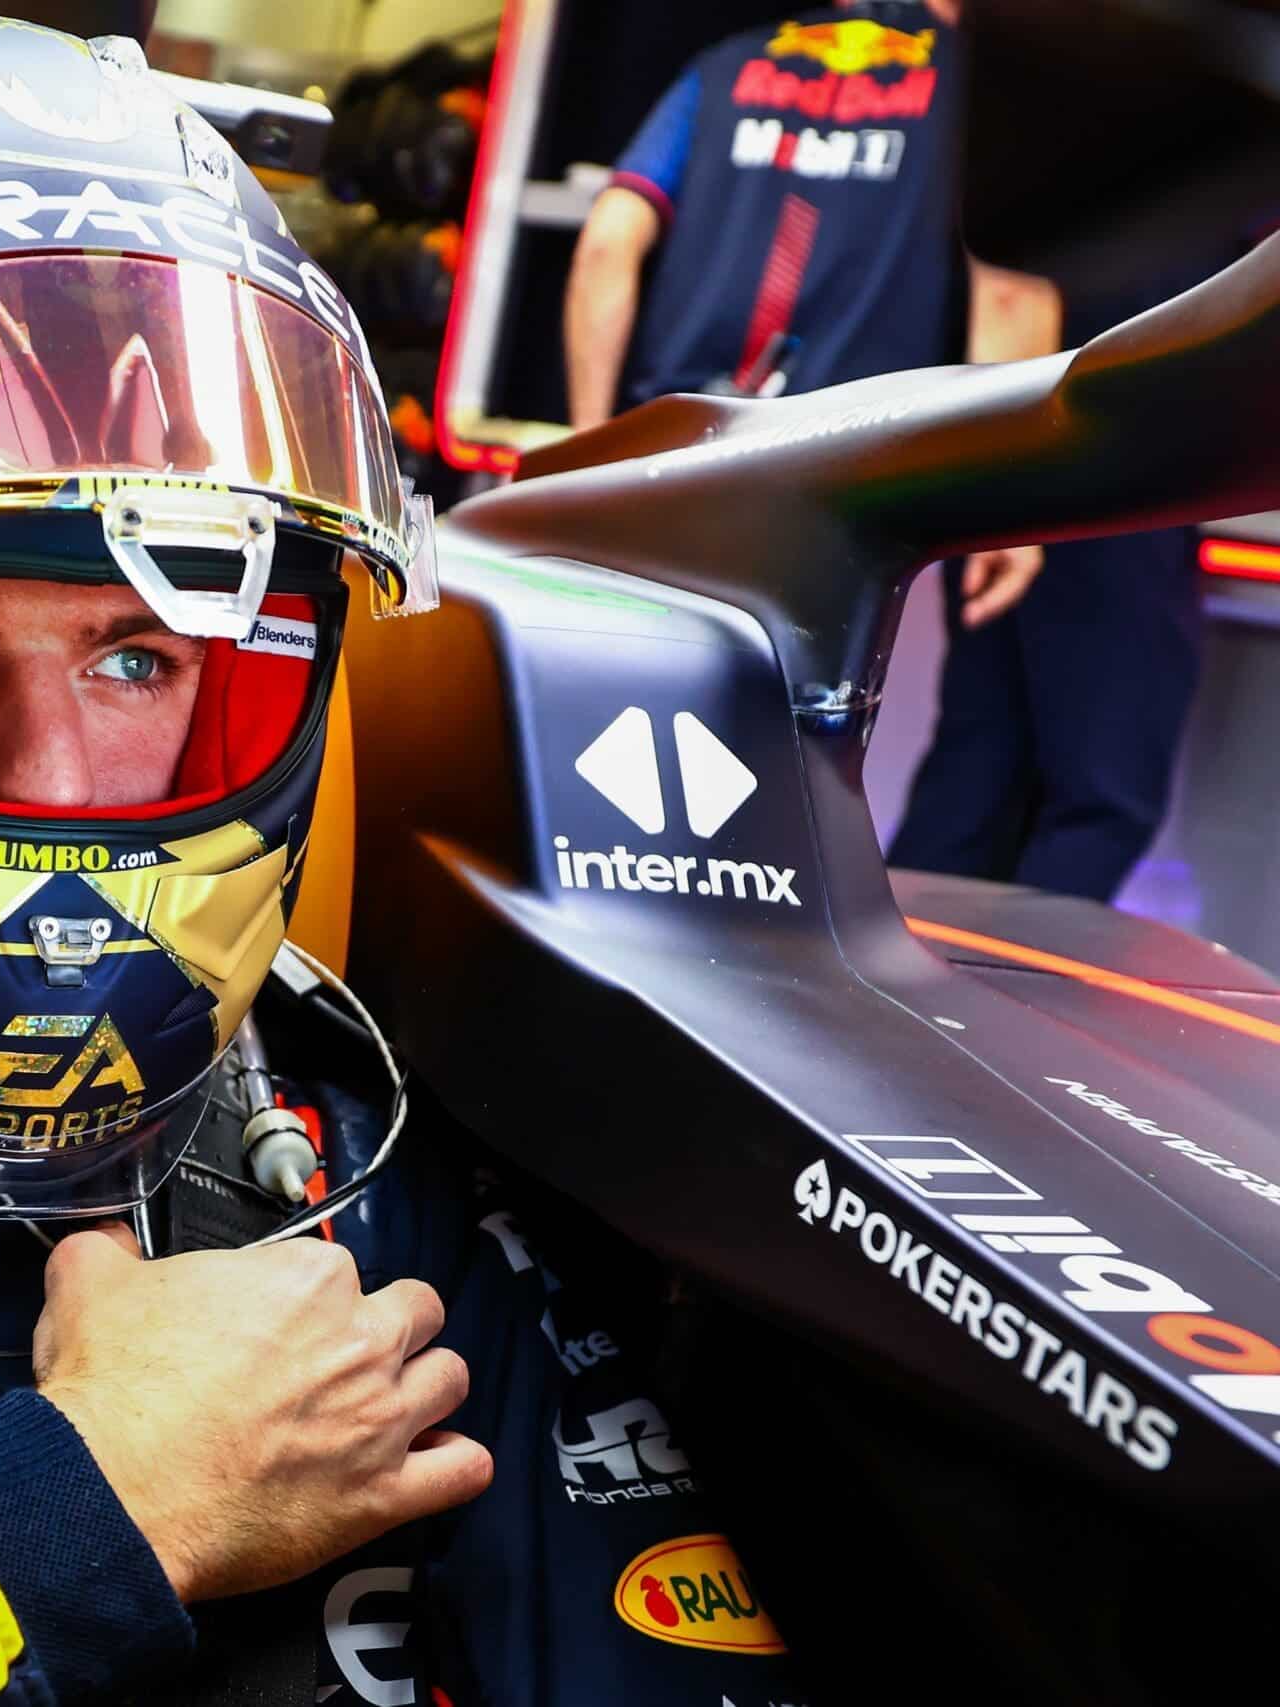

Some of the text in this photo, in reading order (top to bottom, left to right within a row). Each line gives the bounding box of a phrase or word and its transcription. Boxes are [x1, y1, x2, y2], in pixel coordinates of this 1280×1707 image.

[732, 59, 937, 123] Red Bull
[731, 118, 858, 179] Mobil
[257, 626, 314, 648] Blenders
[554, 836, 802, 906] inter.mx
[830, 1187, 1179, 1472] POKERSTARS
